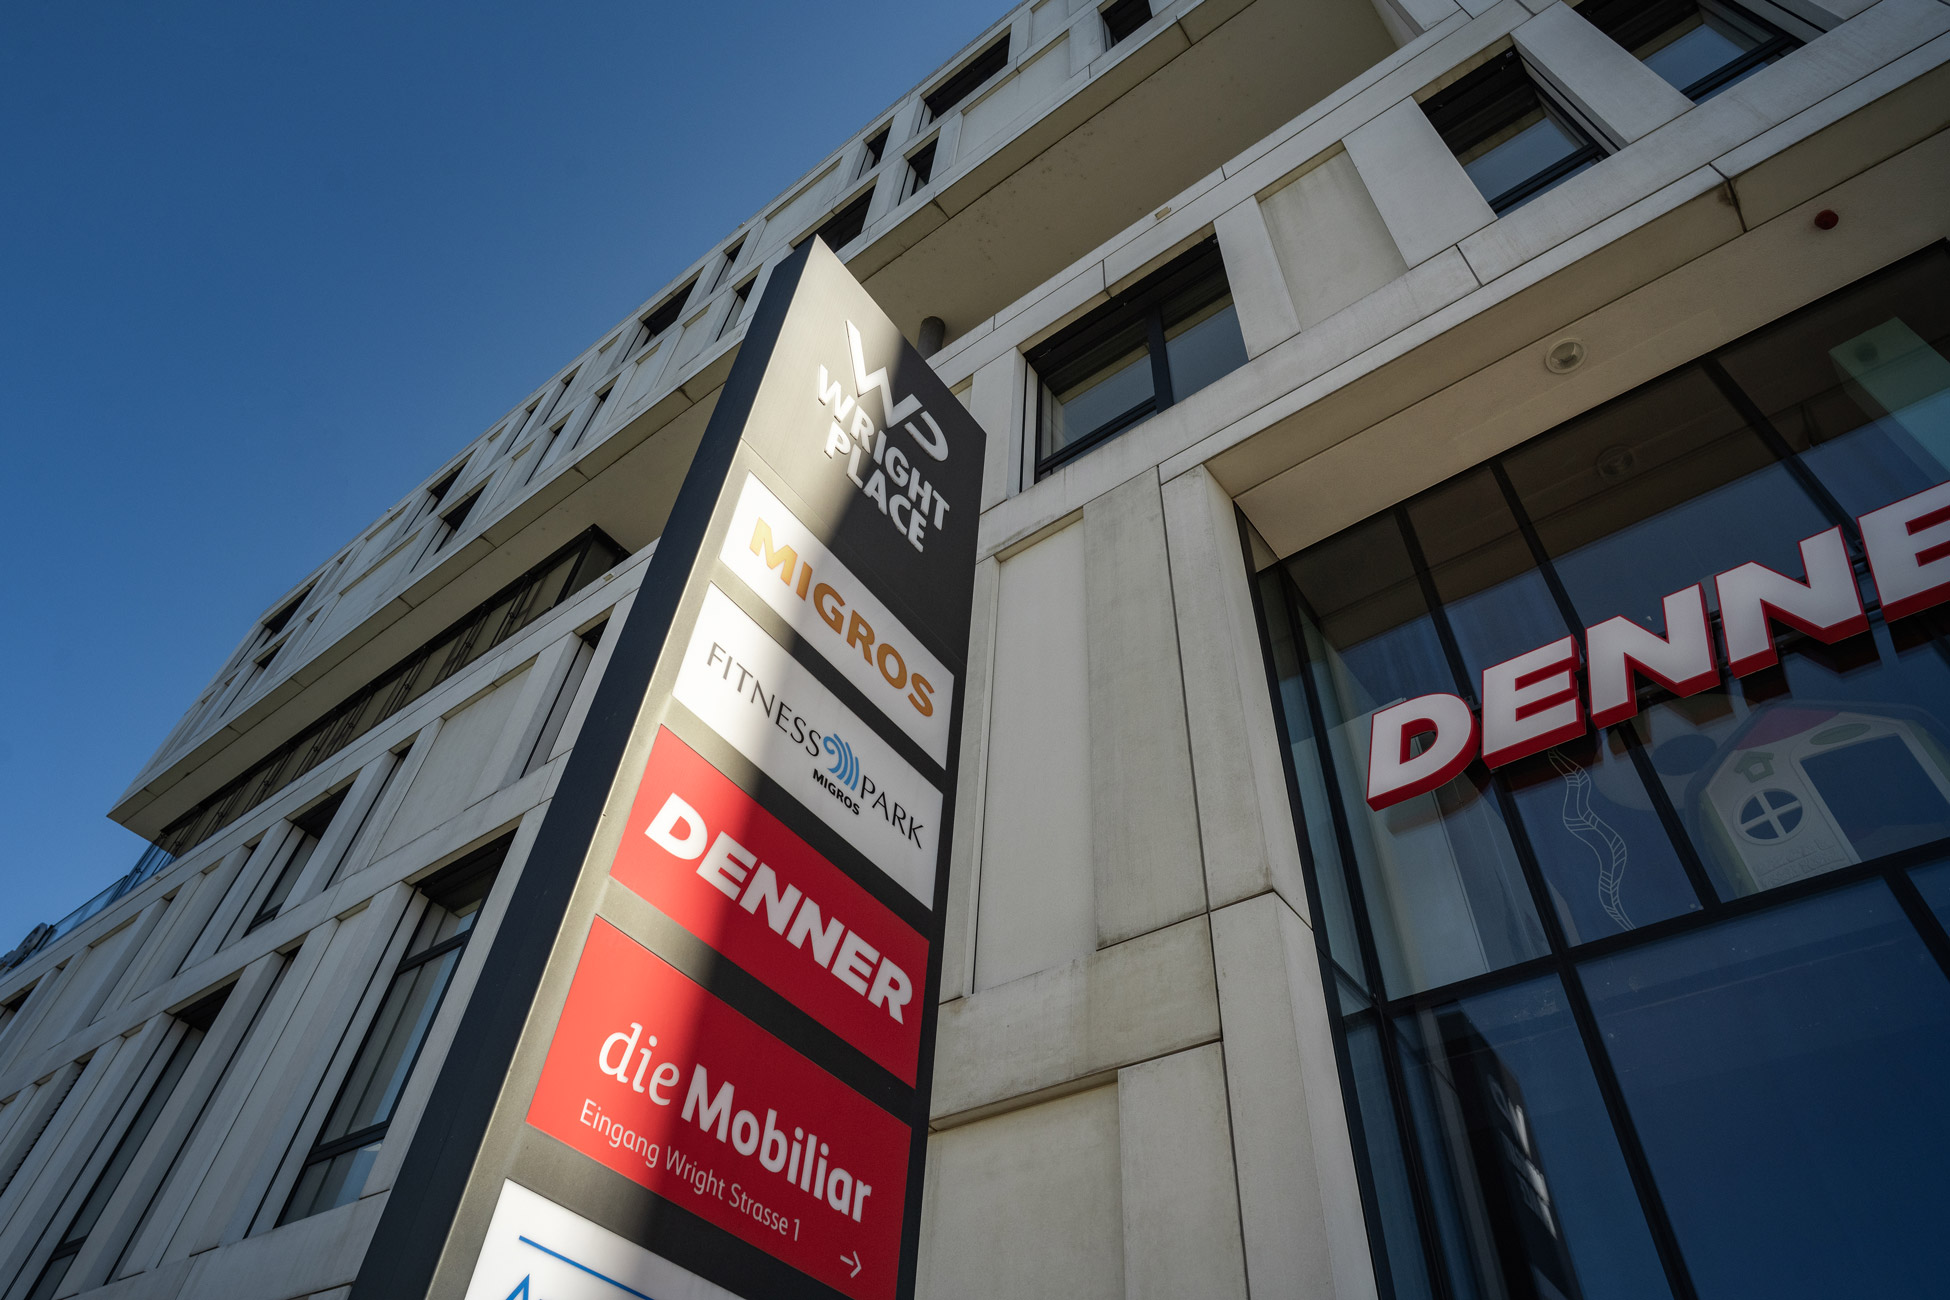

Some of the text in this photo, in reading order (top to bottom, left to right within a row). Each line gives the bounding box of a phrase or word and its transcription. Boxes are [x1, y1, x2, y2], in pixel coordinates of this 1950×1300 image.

[818, 363, 950, 531] WRIGHT
[824, 421, 927, 553] PLACE
[749, 517, 935, 718] MIGROS
[706, 641, 924, 850] FITNESS PARK
[812, 768, 860, 816] MIGROS
[644, 792, 913, 1025] DENNER
[579, 1098, 803, 1242] Eingang Wright Strasse 1
[598, 1022, 872, 1223] die Mobiliar
